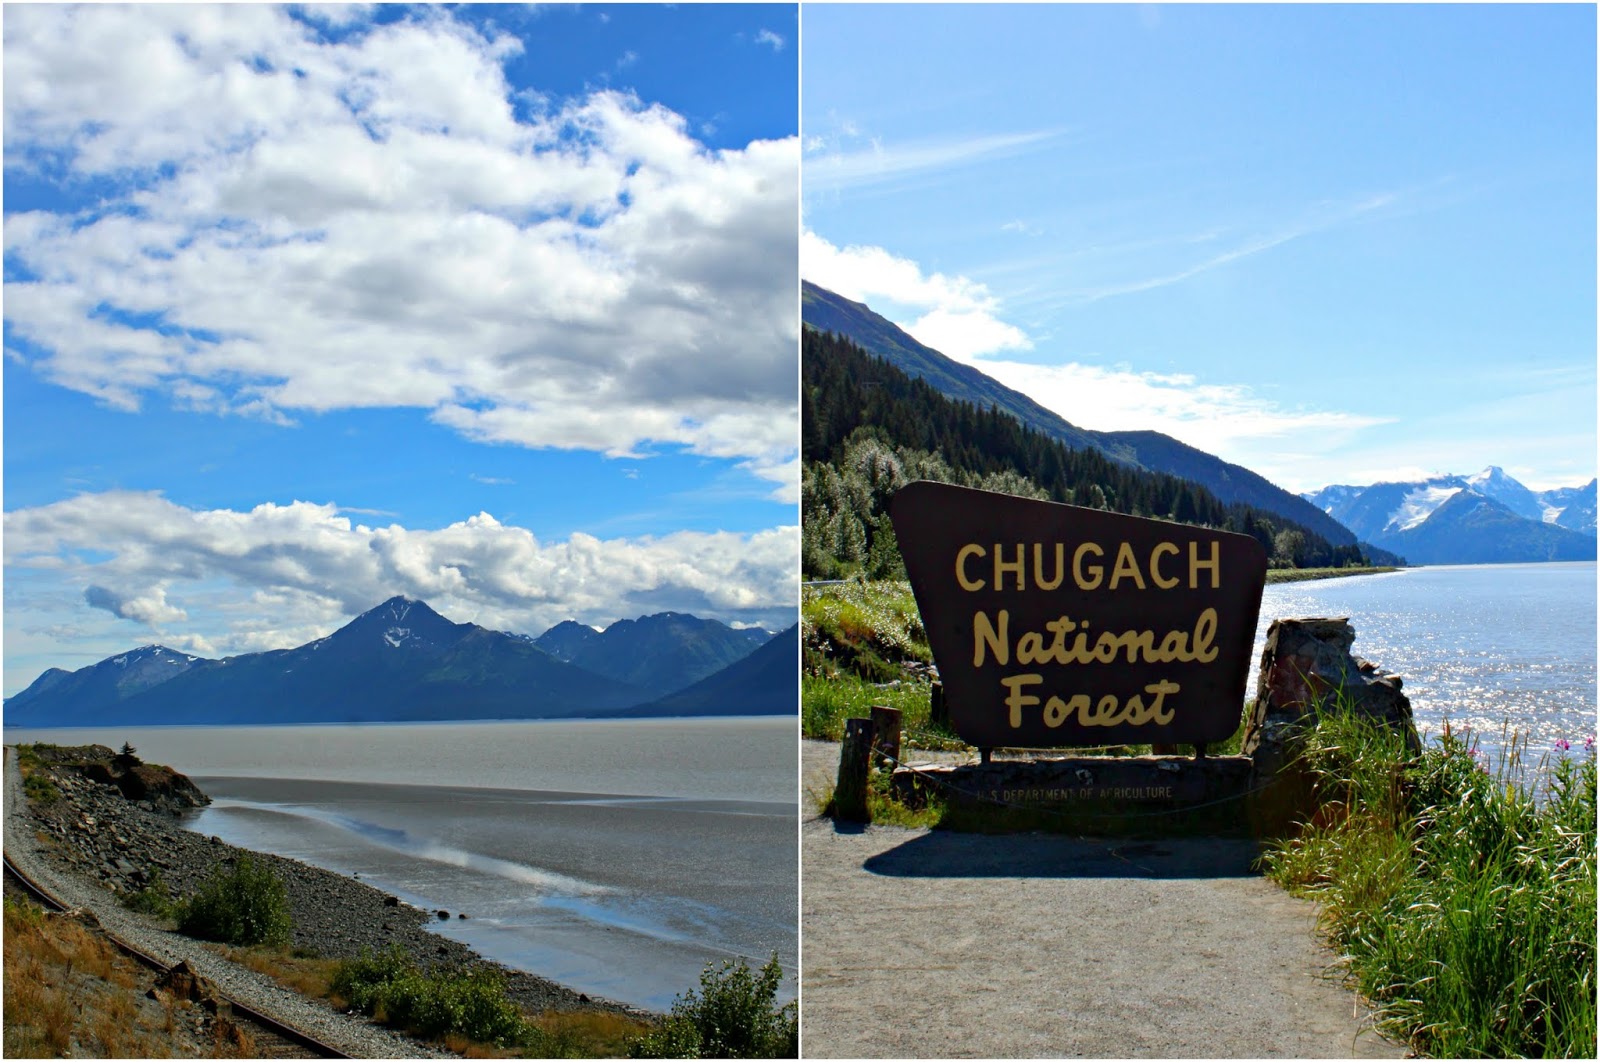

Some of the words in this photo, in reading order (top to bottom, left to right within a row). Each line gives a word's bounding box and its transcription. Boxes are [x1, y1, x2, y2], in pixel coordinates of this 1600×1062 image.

[955, 541, 1221, 592] CHUGACH
[973, 607, 1218, 668] National
[1000, 673, 1180, 729] Forest
[1003, 788, 1073, 801] DEPARTMENT
[1079, 787, 1094, 800] OF
